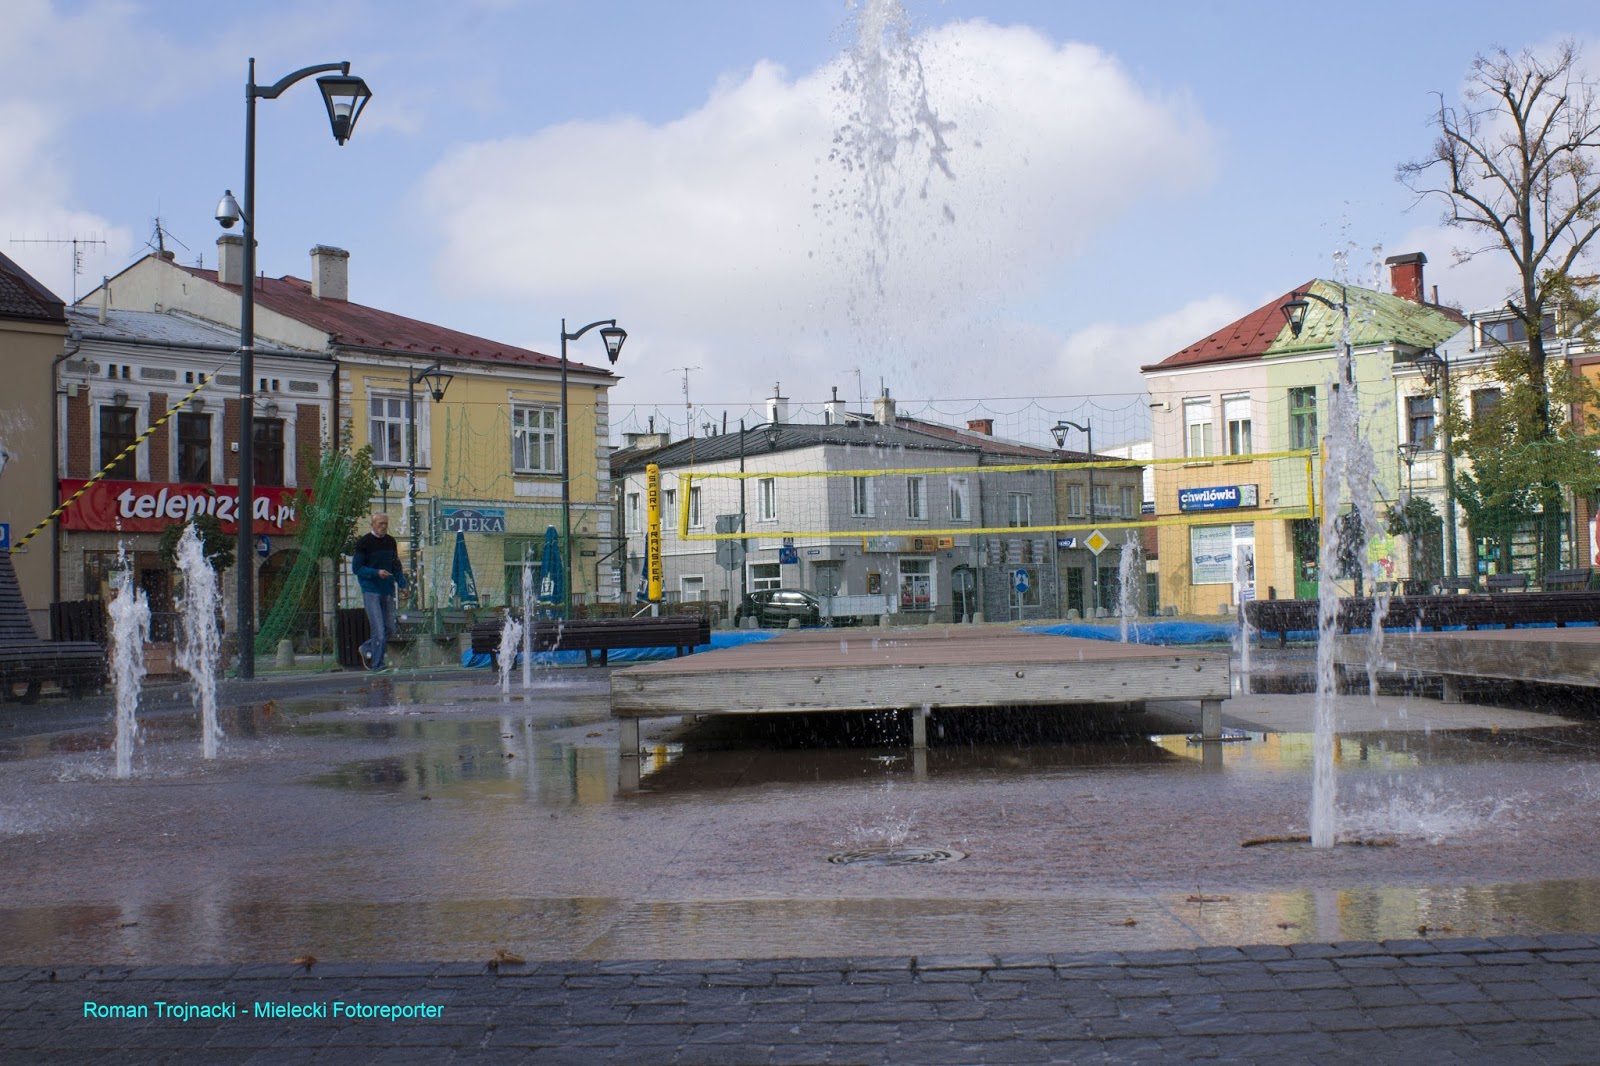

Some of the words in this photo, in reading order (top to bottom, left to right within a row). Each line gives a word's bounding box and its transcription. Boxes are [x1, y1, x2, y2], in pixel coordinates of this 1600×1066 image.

[1181, 489, 1236, 503] chwilówki
[442, 517, 504, 532] PTEKA
[651, 524, 660, 582] TRANSFER
